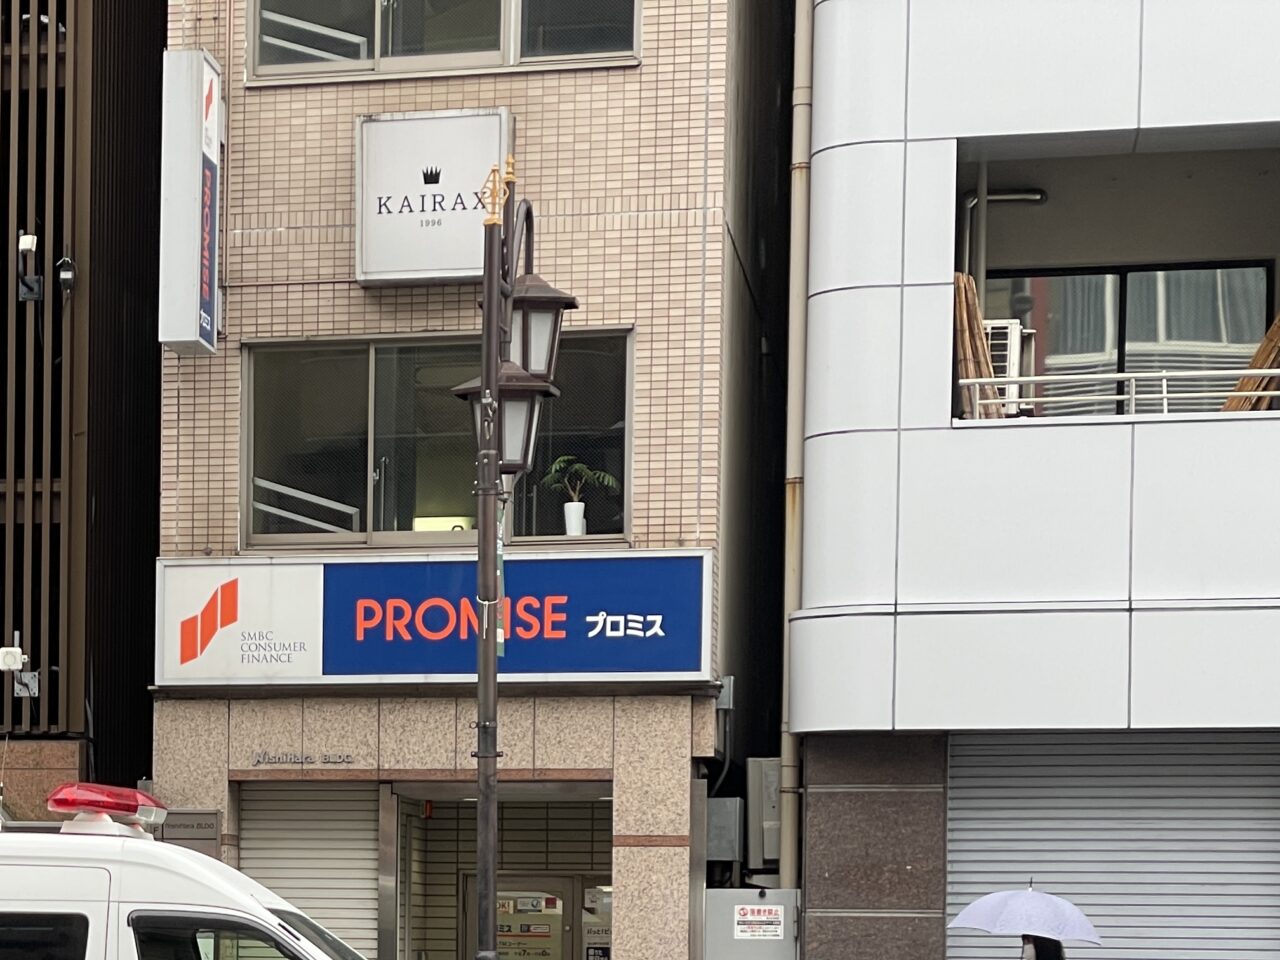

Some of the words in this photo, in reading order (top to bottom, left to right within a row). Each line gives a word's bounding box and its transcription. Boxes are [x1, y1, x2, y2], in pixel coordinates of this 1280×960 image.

[376, 191, 488, 215] KAIRAX
[420, 218, 443, 228] 1996
[584, 612, 666, 638] プロミス
[240, 630, 274, 641] SMBC
[240, 641, 307, 653] CONSUMER
[240, 653, 294, 664] FINANCE
